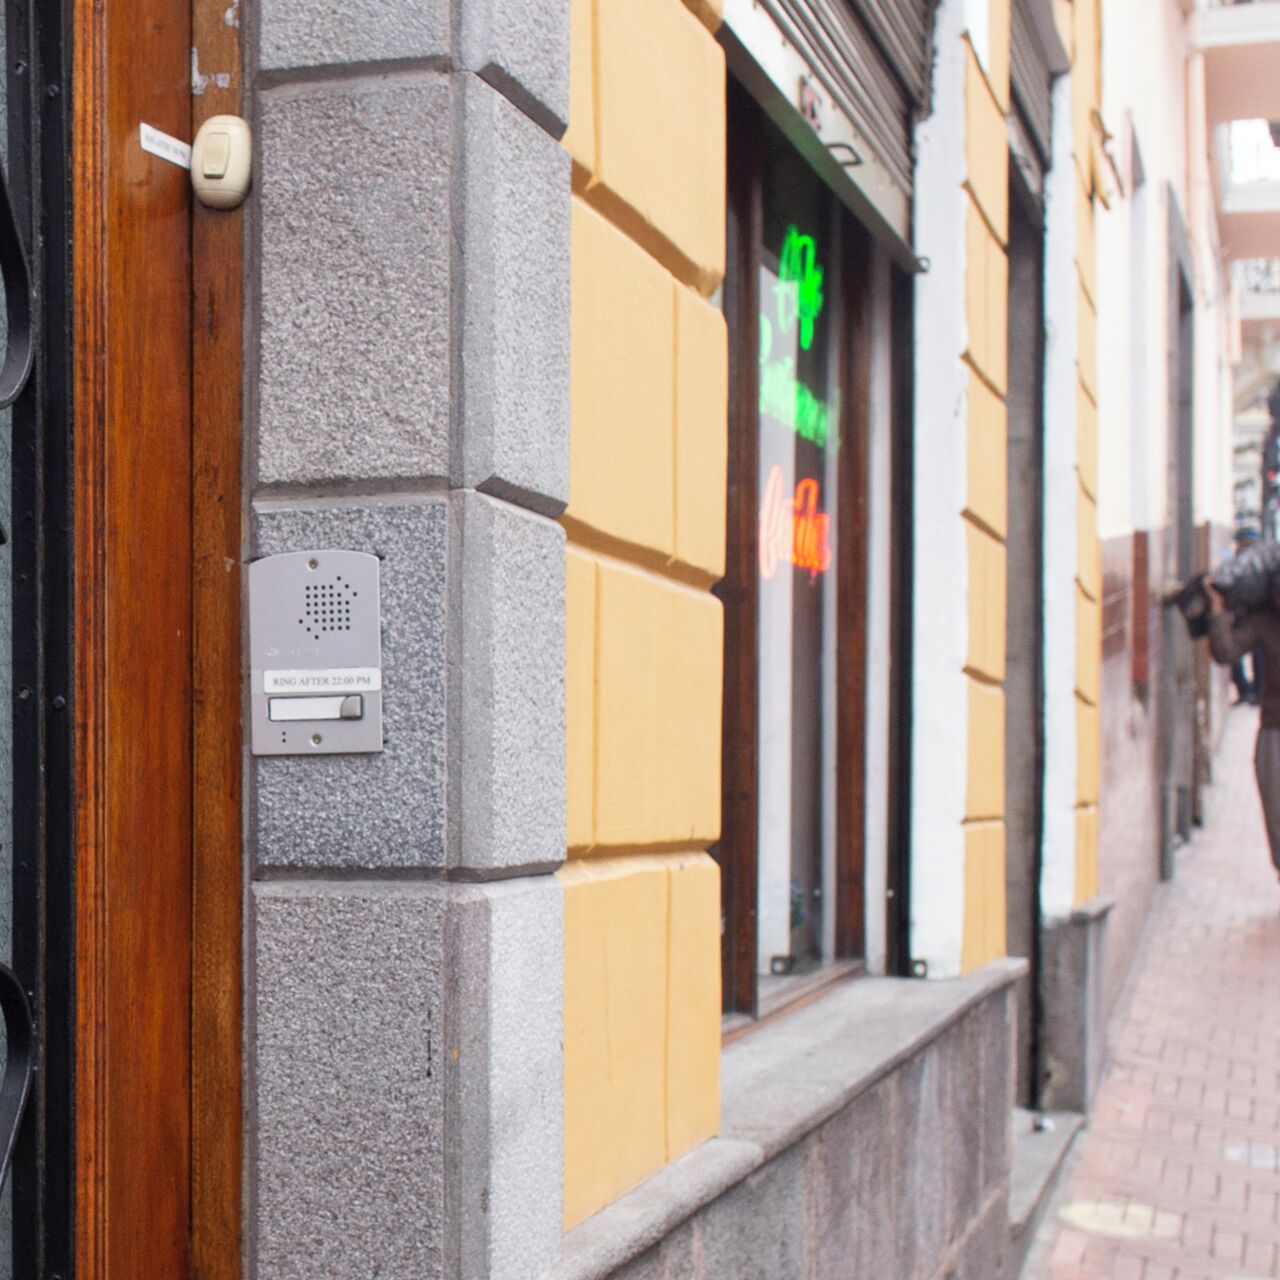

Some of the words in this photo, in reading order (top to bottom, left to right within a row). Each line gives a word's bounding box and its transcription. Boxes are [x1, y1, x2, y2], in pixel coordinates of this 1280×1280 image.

[273, 677, 297, 686] RING
[299, 677, 330, 686] AFTER
[331, 676, 354, 685] 22:00
[356, 676, 371, 685] PM
